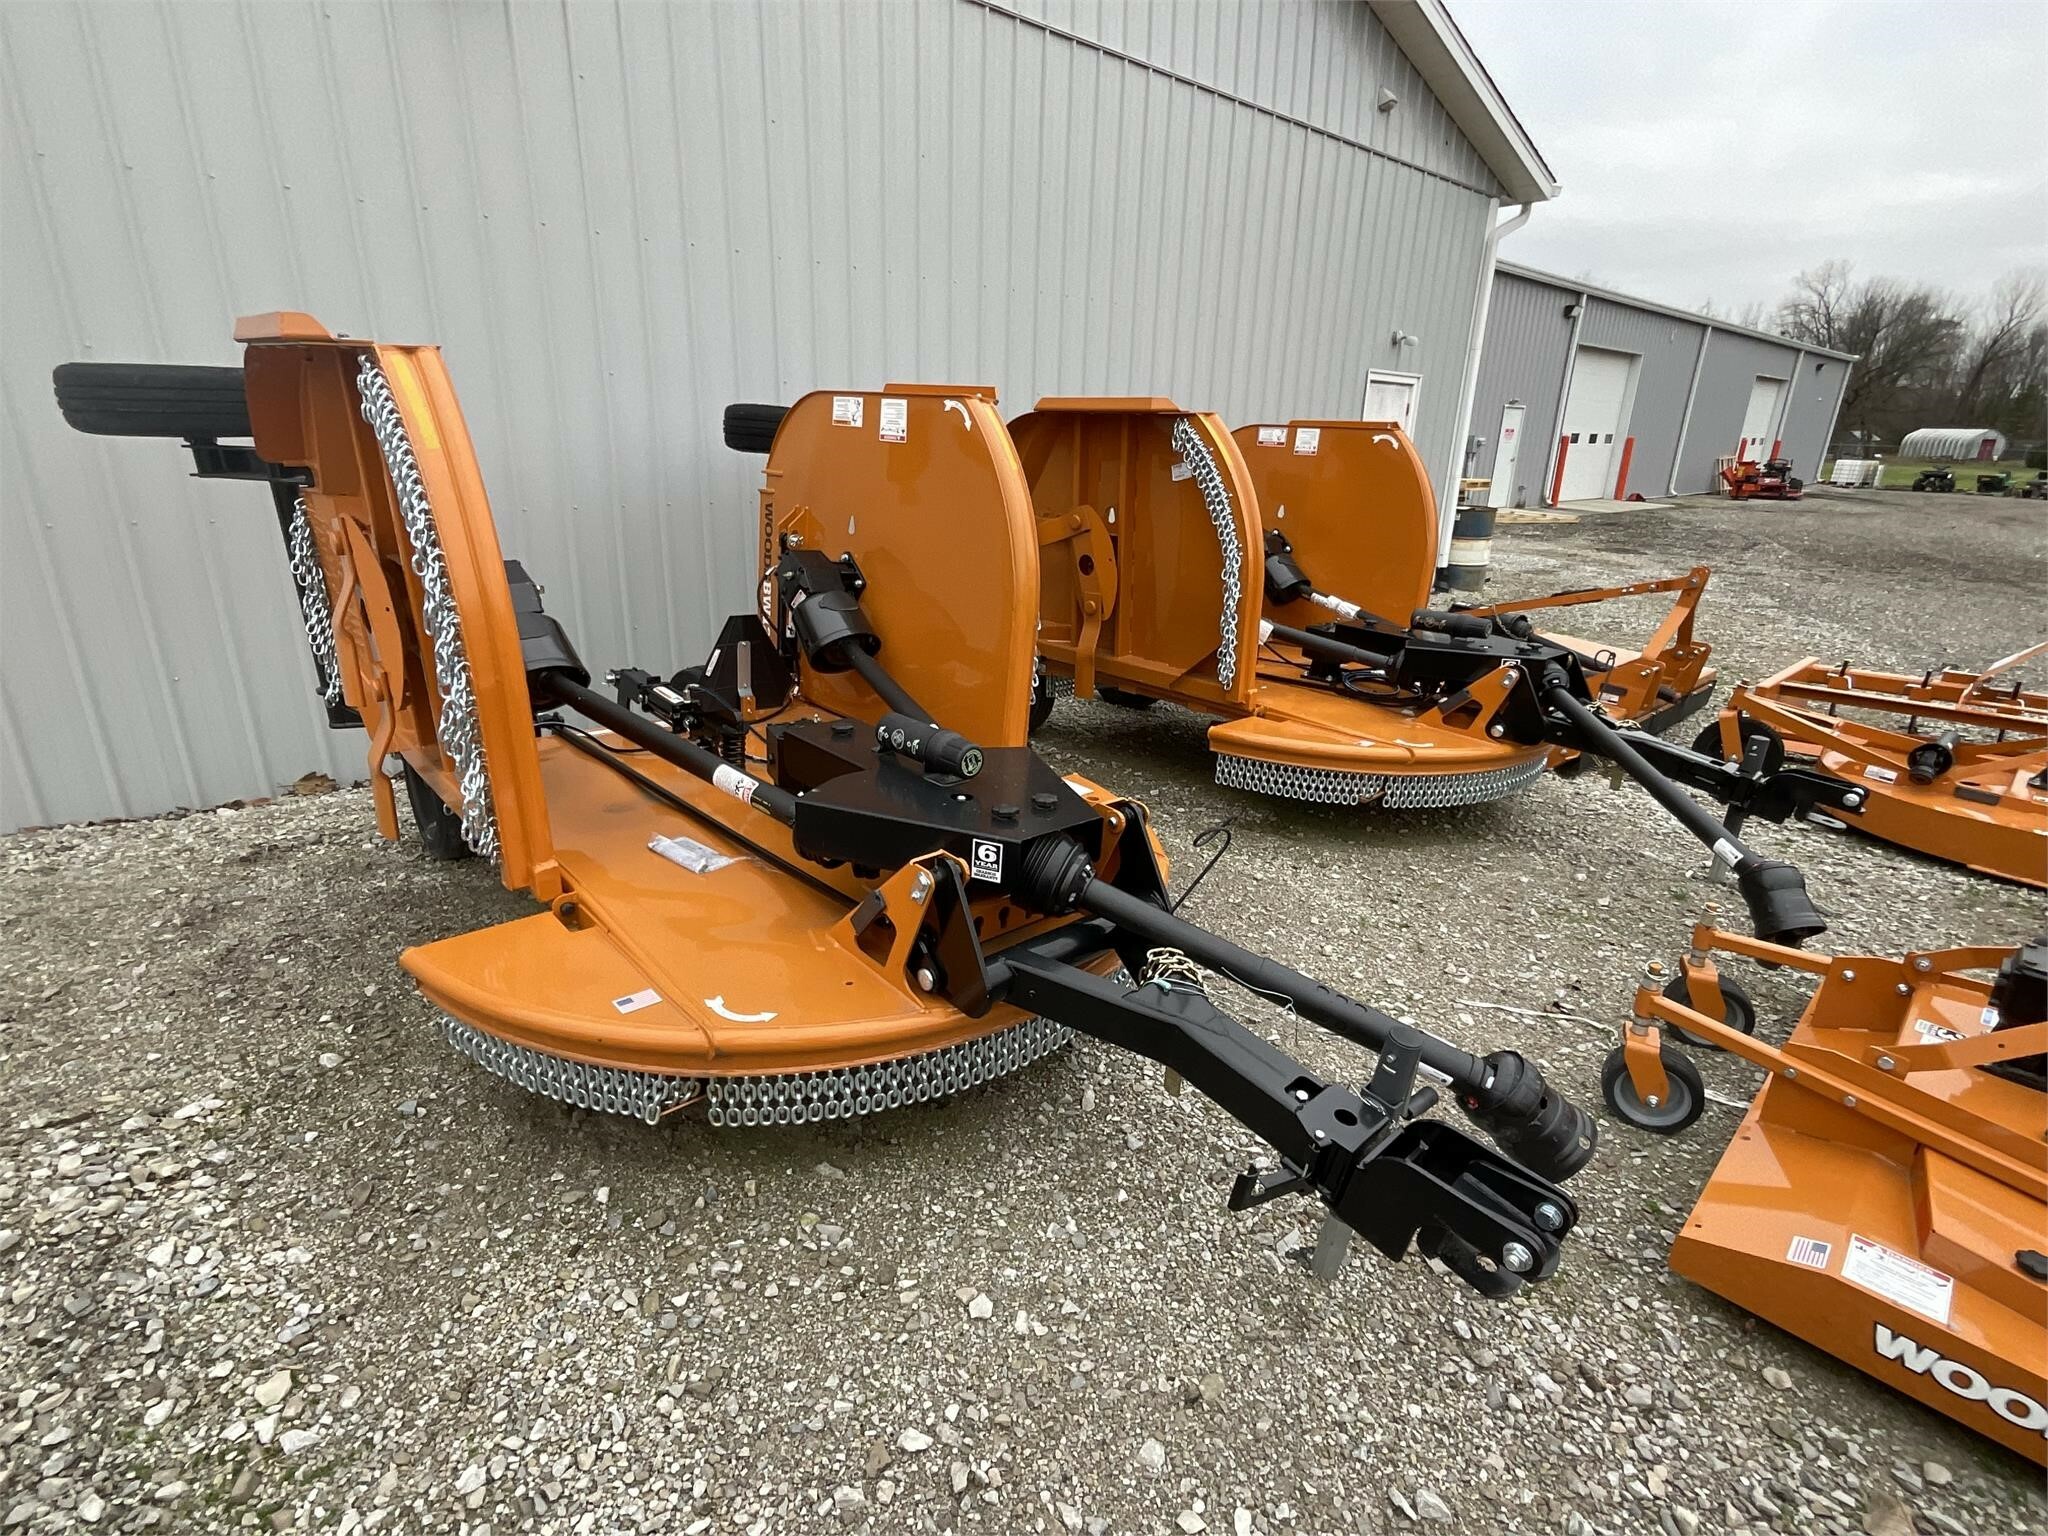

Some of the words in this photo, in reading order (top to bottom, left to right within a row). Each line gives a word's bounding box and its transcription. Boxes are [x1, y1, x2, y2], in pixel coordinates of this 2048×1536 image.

[764, 502, 773, 571] WOOD
[975, 860, 998, 870] YEAR
[978, 844, 997, 862] 6
[1874, 1322, 2047, 1440] WOO
